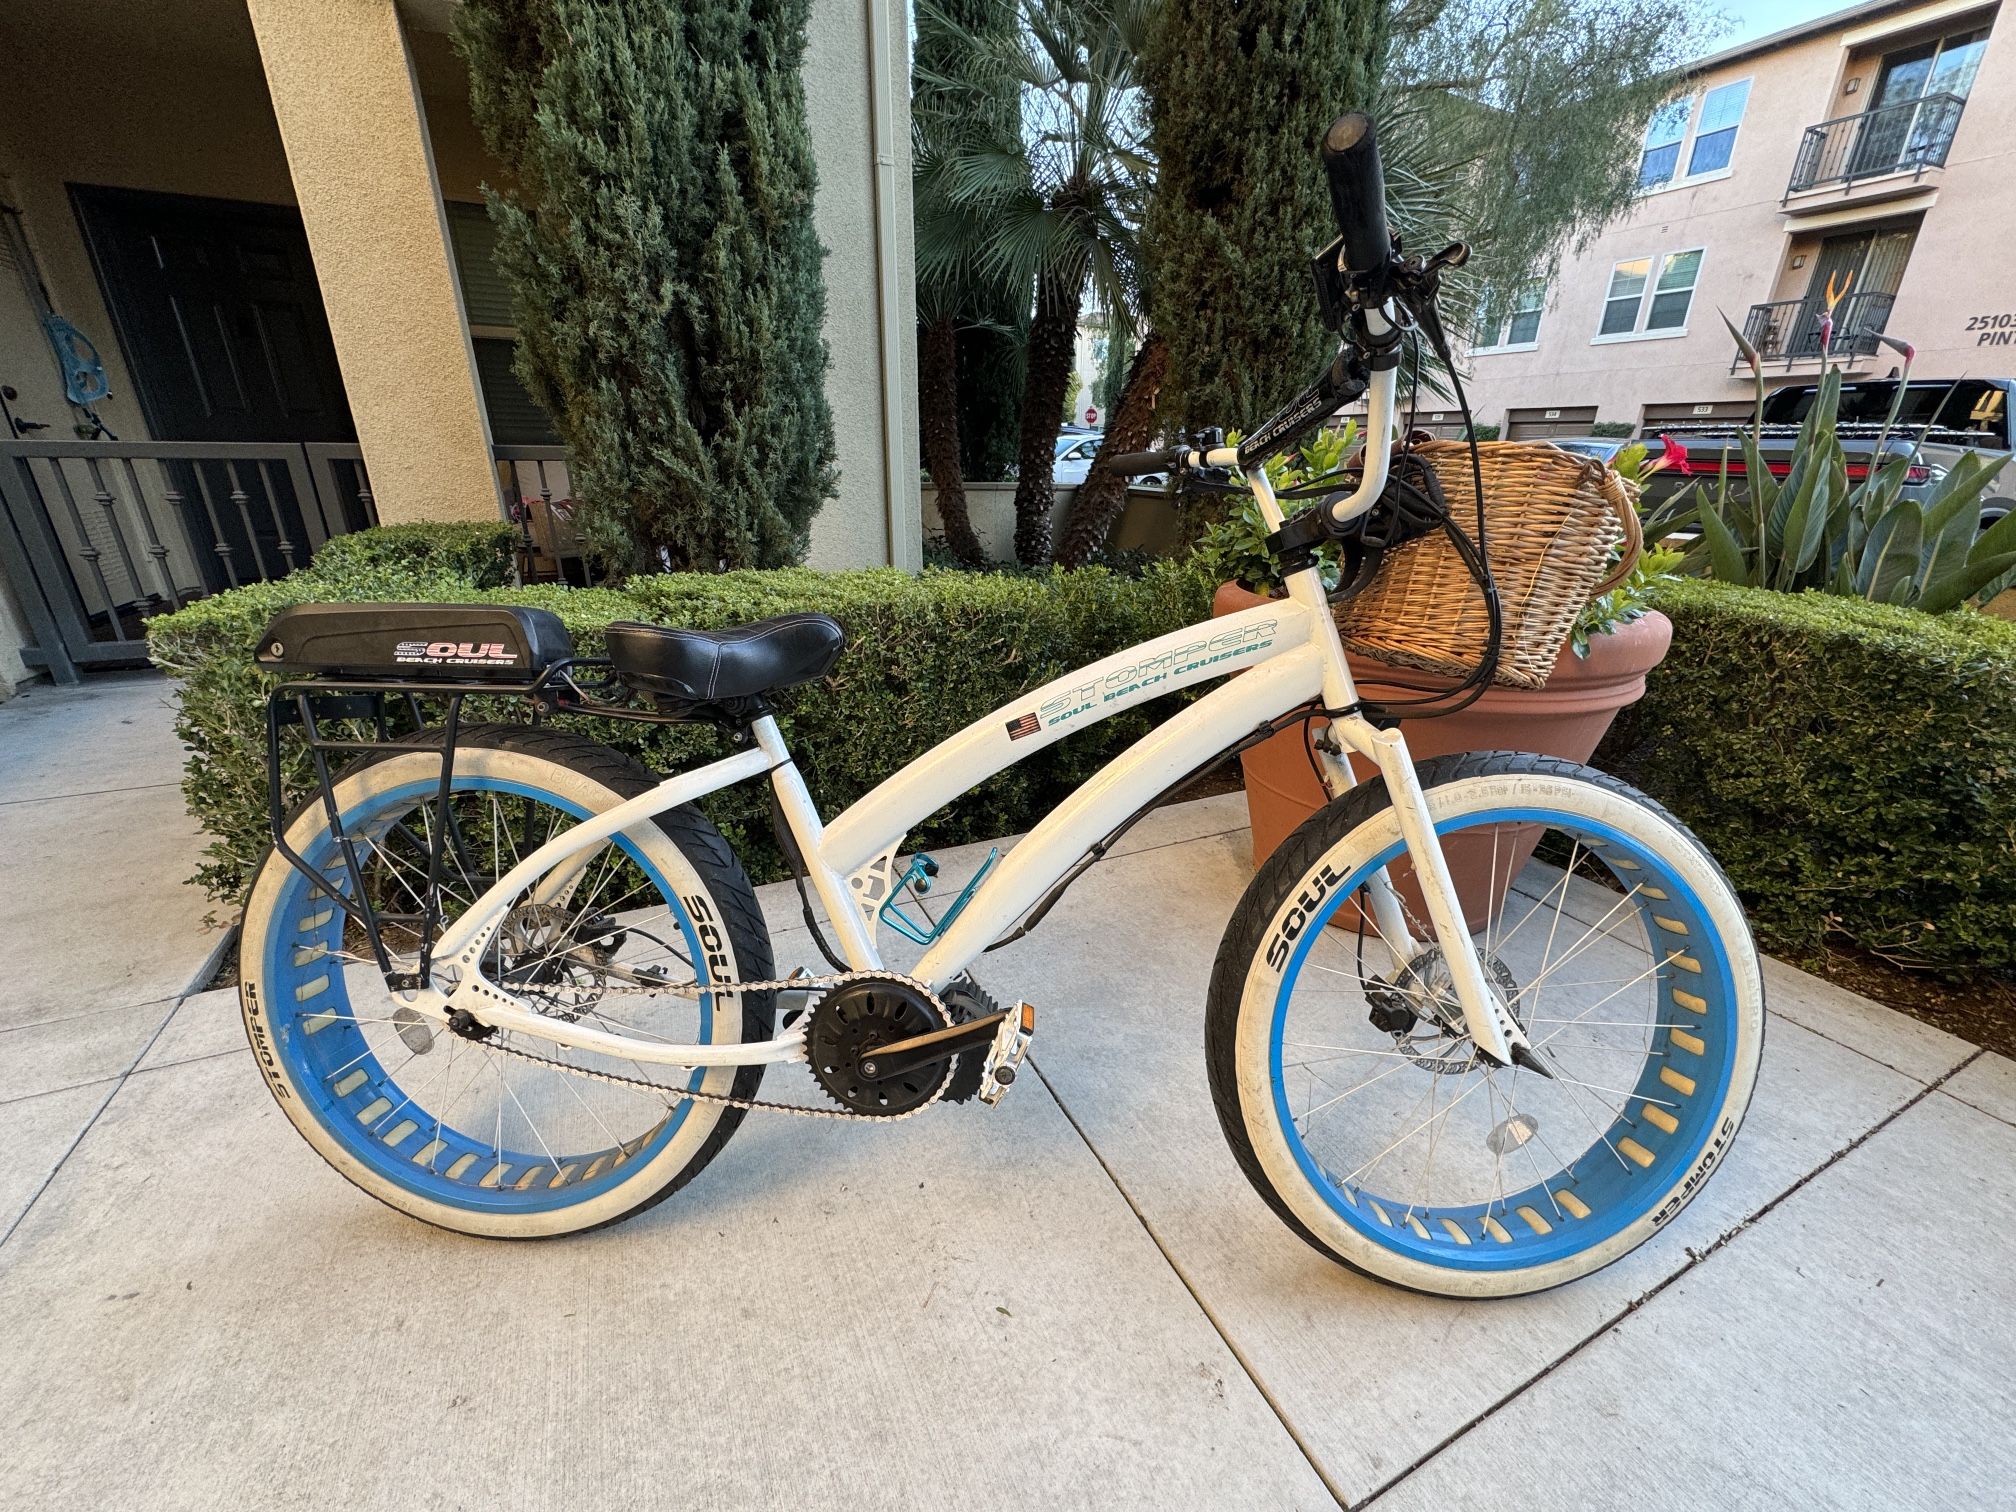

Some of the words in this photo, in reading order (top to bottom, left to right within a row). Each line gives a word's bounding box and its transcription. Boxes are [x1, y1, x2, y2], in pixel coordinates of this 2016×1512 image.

[1244, 432, 1272, 455] BEACH
[1272, 396, 1322, 438] CRUISERS
[393, 641, 518, 659] SOUL
[396, 656, 442, 664] BEACH
[1040, 619, 1278, 719] STOMPER
[1048, 702, 1097, 727] SOUL
[1103, 672, 1168, 702] BEACH
[1174, 639, 1273, 675] CRUISERS
[683, 894, 734, 1012] SOUL
[1266, 863, 1352, 974] SOUL
[244, 981, 291, 1099] STOMPER
[1651, 1116, 1734, 1227] STOMPER
